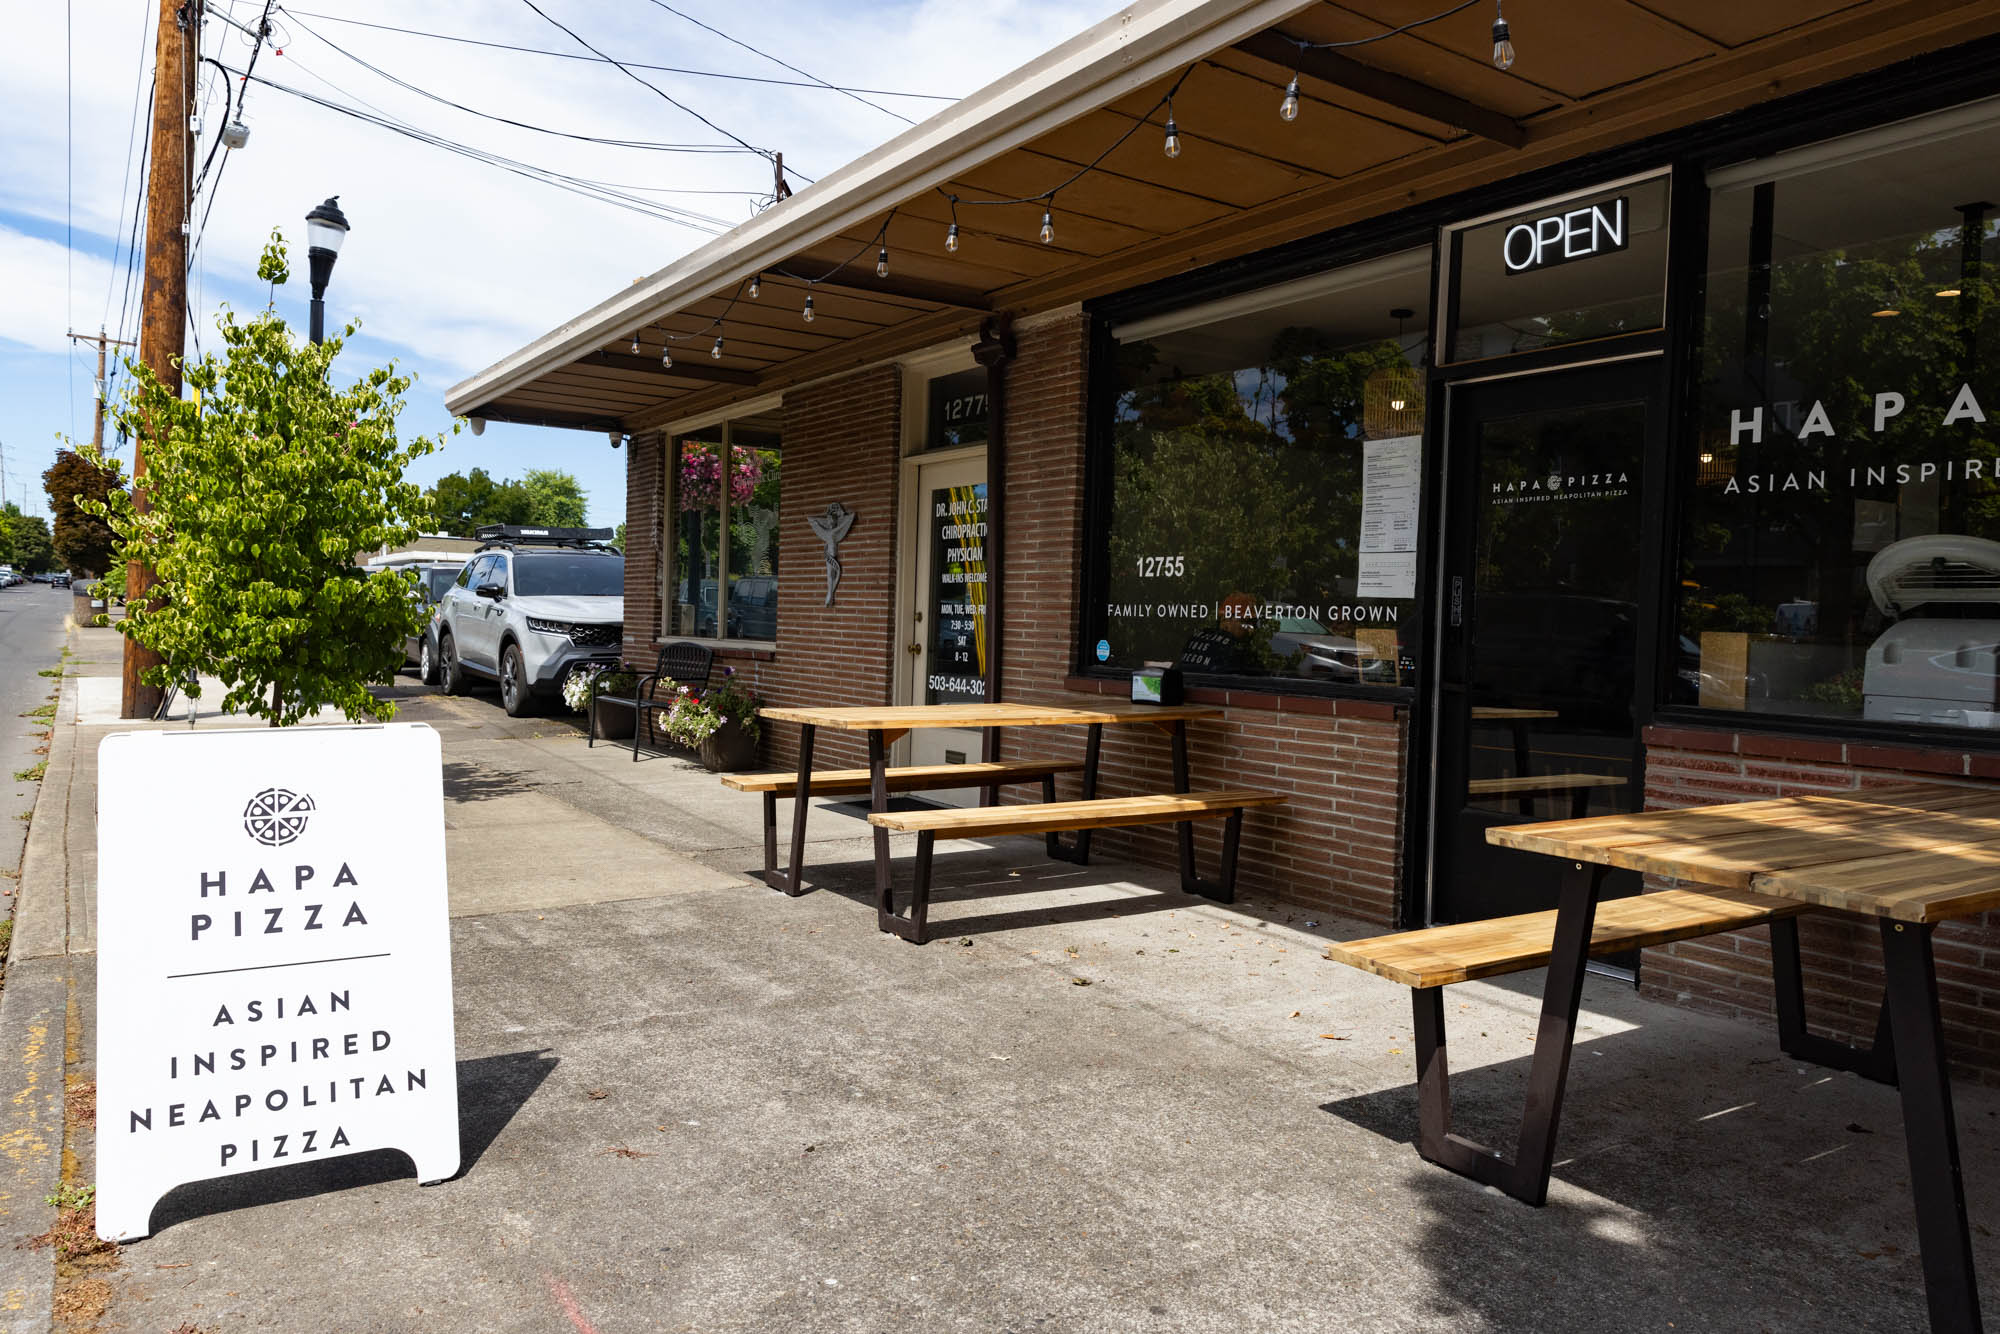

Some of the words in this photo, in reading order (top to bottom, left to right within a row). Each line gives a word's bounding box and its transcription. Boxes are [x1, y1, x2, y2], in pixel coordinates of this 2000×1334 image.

[1504, 199, 1621, 270] OPEN
[1730, 382, 1986, 446] HAPA
[1492, 480, 1540, 493] HAPA
[1568, 472, 1628, 487] PIZZA
[1724, 470, 1825, 494] ASIAN
[1516, 495, 1550, 503] INSPIRED
[1554, 491, 1601, 500] NEAPOLITAN
[936, 503, 947, 517] DR.
[949, 500, 966, 516] JOHN
[947, 546, 983, 562] PHYSICIAN
[1136, 556, 1184, 577] 12755
[964, 572, 988, 583] WELCOME
[1107, 604, 1152, 617] FAMILY
[1157, 604, 1208, 618] OWNED
[1224, 605, 1319, 620] BEAVERTON
[1328, 605, 1398, 622] GROWN
[957, 636, 967, 646] SAT
[962, 652, 968, 662] 12
[928, 675, 985, 695] 503-644-30
[200, 862, 358, 898] HAPA
[191, 901, 368, 941] PIZZA
[213, 990, 350, 1027] ASIAN
[170, 1030, 391, 1079] INSPIRED
[130, 1068, 427, 1133] NEAPOLITAN
[221, 1126, 350, 1167] PIZZA
